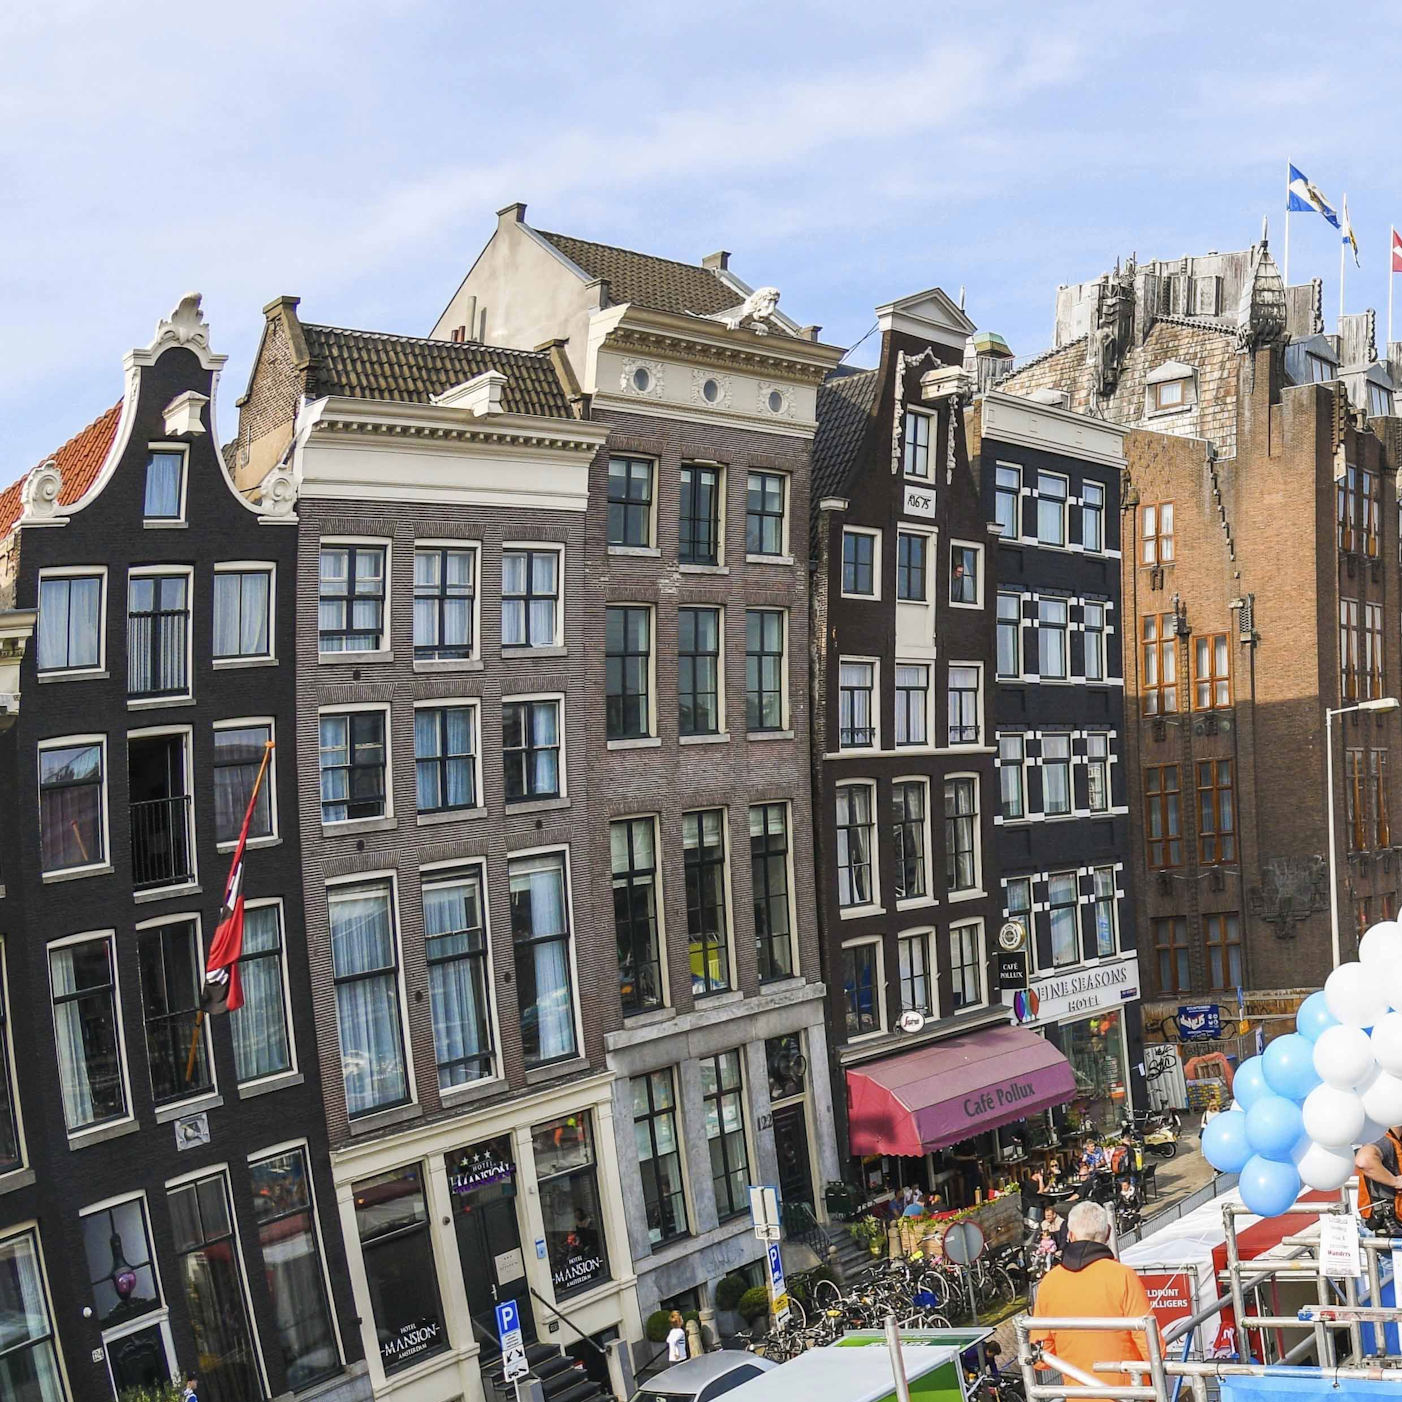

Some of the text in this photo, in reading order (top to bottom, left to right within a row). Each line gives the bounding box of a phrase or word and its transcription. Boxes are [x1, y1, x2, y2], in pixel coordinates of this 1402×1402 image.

[1002, 962, 1019, 970] CAFÉ
[1071, 967, 1128, 994] SEASONS
[963, 1082, 1036, 1118] Café Pollux
[757, 1114, 774, 1132] 122
[400, 1322, 417, 1334] HOTEL
[502, 1306, 514, 1331] P
[382, 1323, 440, 1357] MANSION
